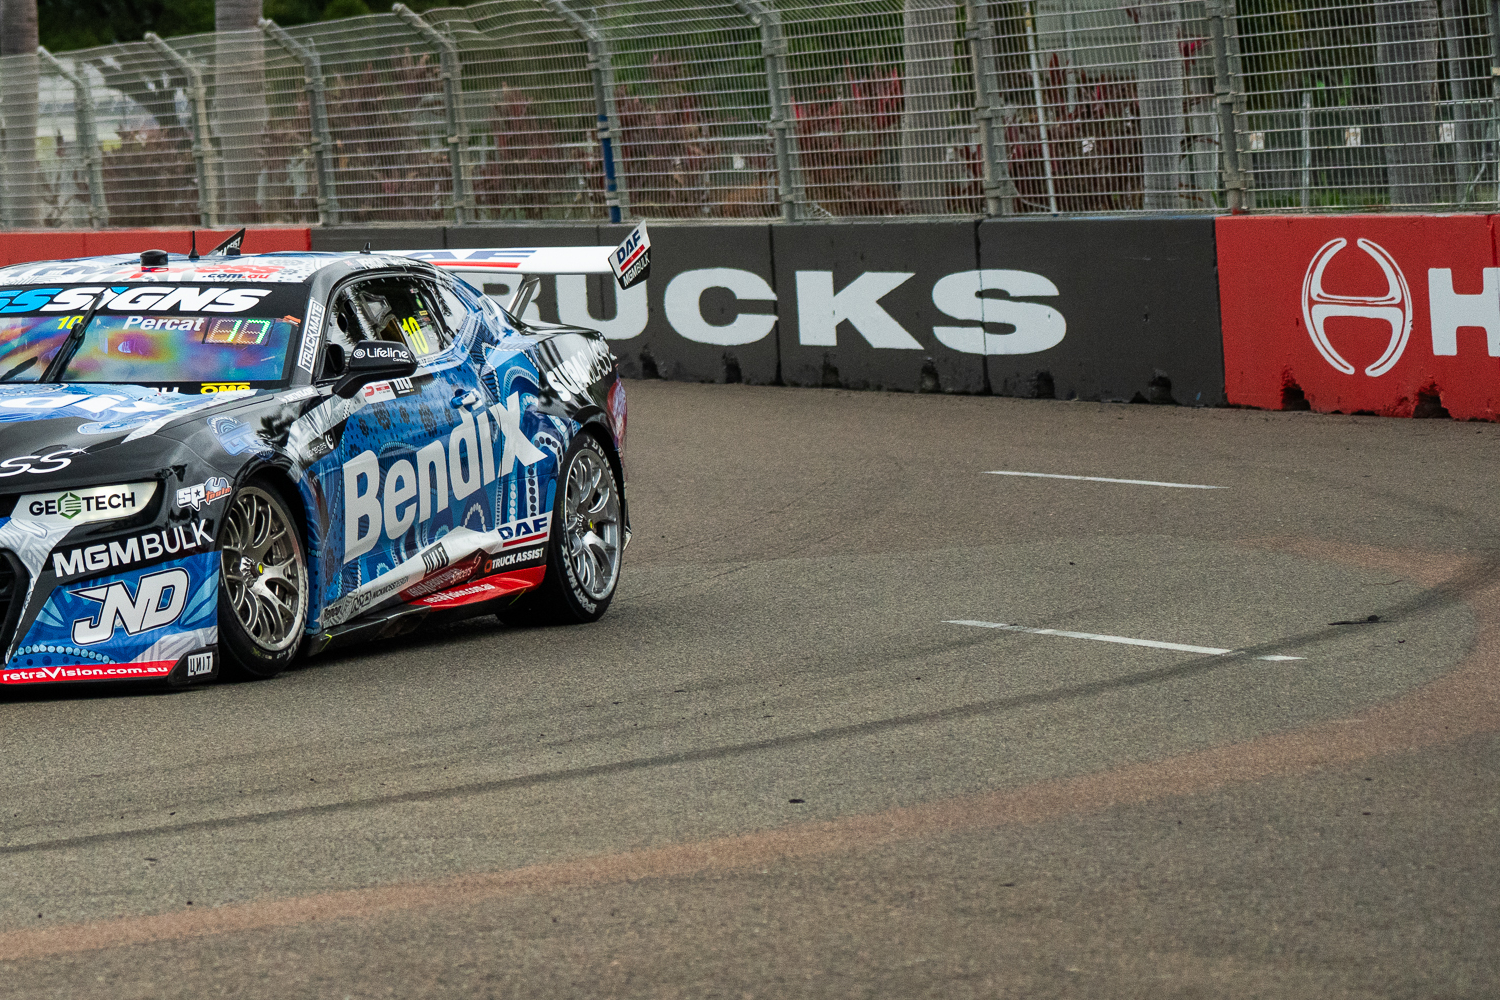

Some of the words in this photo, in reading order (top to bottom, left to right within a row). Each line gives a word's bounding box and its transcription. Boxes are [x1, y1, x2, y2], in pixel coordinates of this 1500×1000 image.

[400, 250, 538, 260] AF
[617, 229, 641, 265] DAF
[622, 252, 651, 288] MGMBULK
[57, 316, 85, 330] 10
[122, 315, 204, 331] Percat
[455, 267, 1067, 356] RUCKS
[301, 304, 324, 372] TRUCKMATE
[366, 347, 409, 359] Lifeline
[401, 316, 429, 355] 10
[343, 391, 548, 564] Bendix
[498, 517, 547, 540] DAF
[53, 519, 214, 578] MGMBULK
[3, 667, 168, 682] retraVision.com.au
